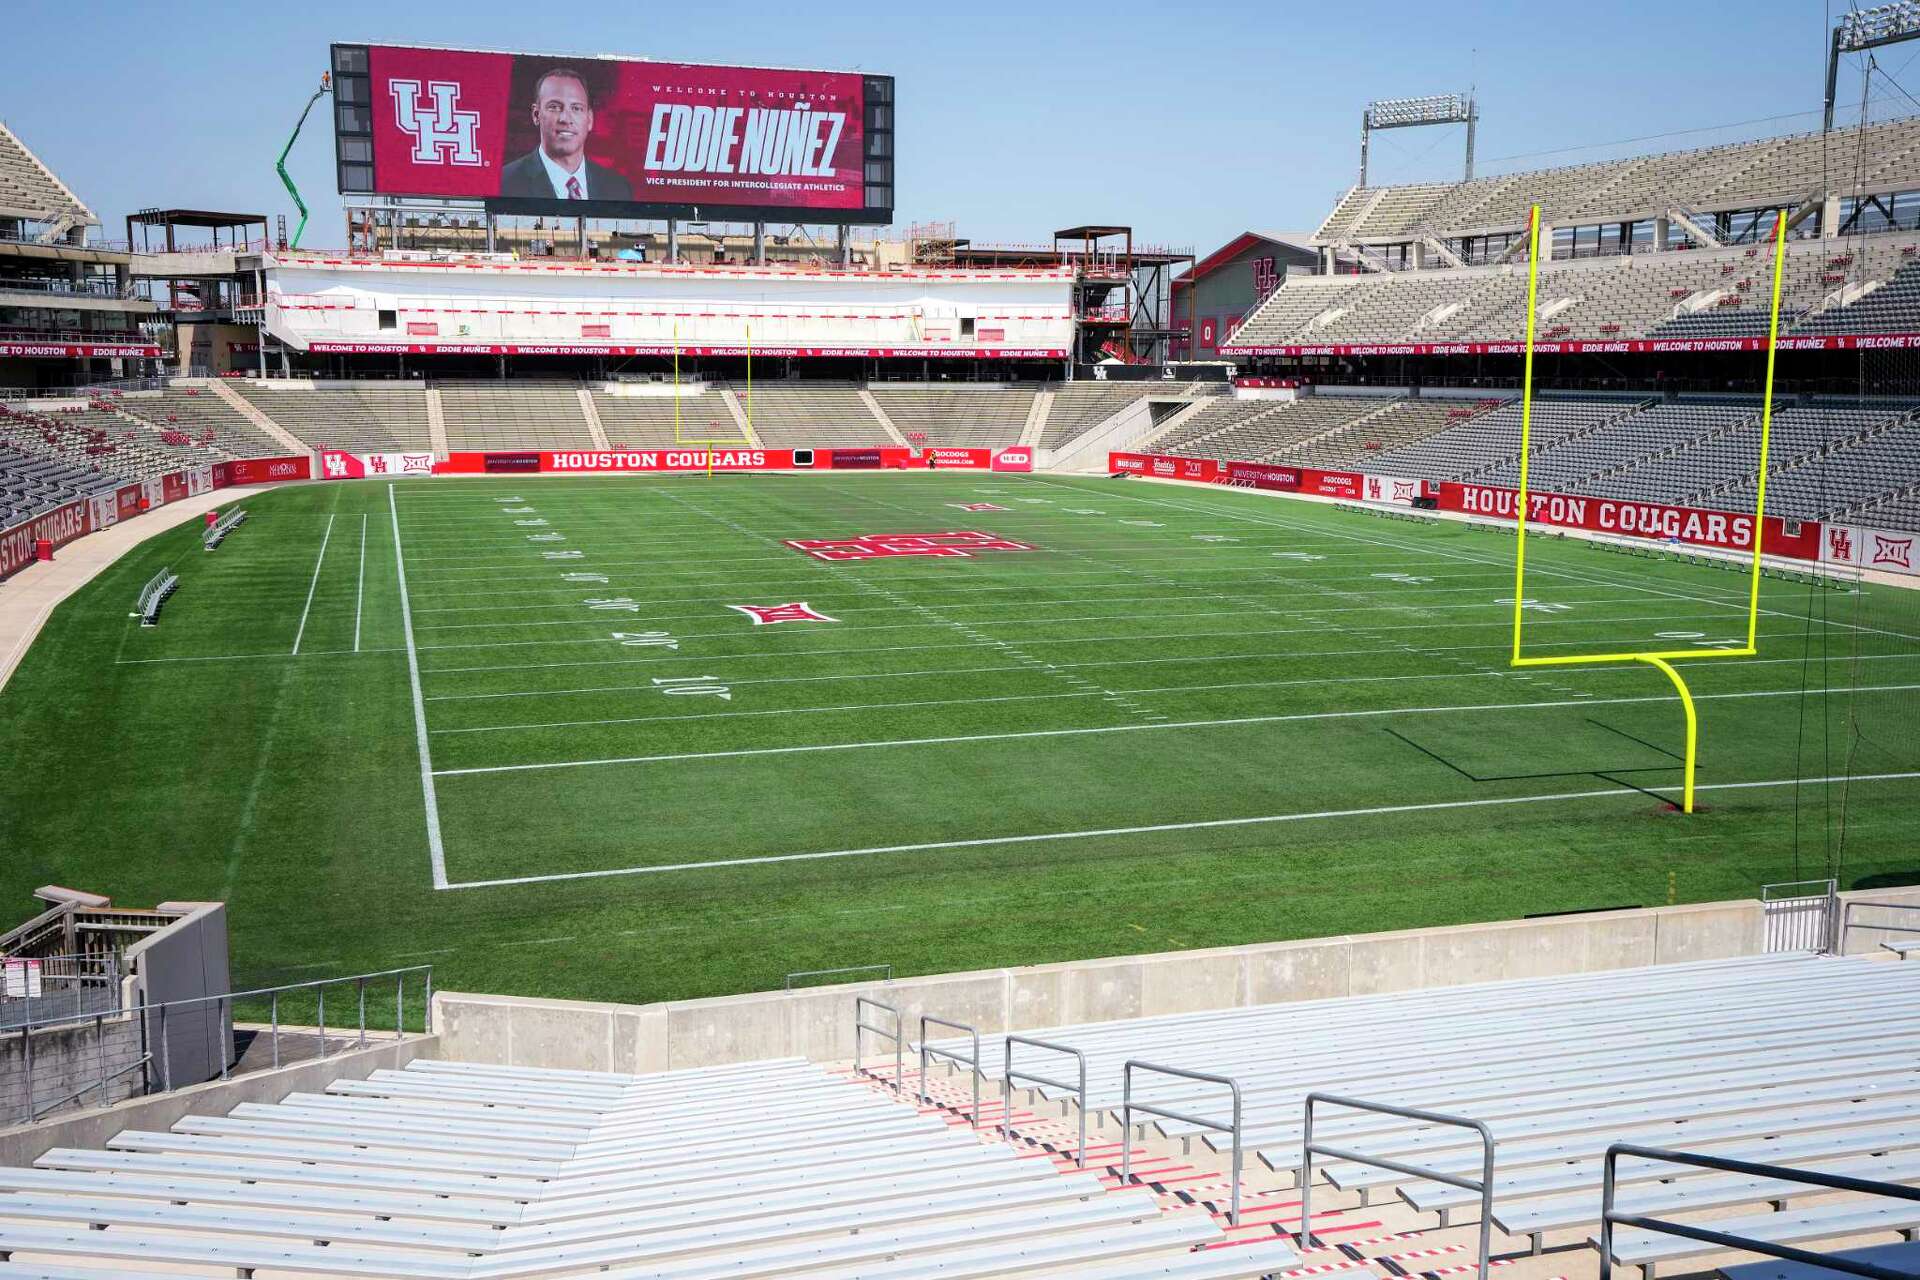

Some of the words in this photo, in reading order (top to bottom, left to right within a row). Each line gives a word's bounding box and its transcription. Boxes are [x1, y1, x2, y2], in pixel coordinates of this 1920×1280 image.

[652, 85, 727, 96] WELCOME
[768, 92, 837, 101] HOUSTON
[389, 79, 481, 167] UH
[644, 103, 744, 173] EDDIE
[738, 101, 846, 177] NUÑEZ
[646, 177, 665, 185] VICE
[667, 178, 711, 187] PRESIDENT
[713, 180, 730, 188] FOR
[731, 181, 801, 190] INTERCOLLEGIATE
[803, 183, 845, 192] ATHLETICS
[314, 344, 353, 352] WELCOME
[1582, 343, 1604, 352] EDDIE
[1653, 342, 1692, 351] WELCOME
[1693, 342, 1704, 350] TO
[1704, 341, 1742, 350] HOUSTON
[1795, 337, 1826, 349] NUÑEZ
[1856, 337, 1904, 348] WELCOME
[1907, 336, 1920, 347] TO
[11, 346, 21, 355] TO
[24, 346, 66, 356] HOUSTON
[93, 348, 117, 356] EDDIE
[517, 346, 559, 354] WELCOME
[571, 347, 609, 355] HOUSTON
[1351, 347, 1378, 355] WELCOME
[1386, 346, 1415, 354] HOUSTON
[553, 453, 657, 468] HOUSTON
[666, 452, 765, 467] COUGARS
[1233, 469, 1262, 480] UNIVERSITY
[1267, 472, 1294, 483] HOUSTON
[35, 505, 83, 546] COUGARS
[1599, 502, 1752, 546] COUGARS
[1829, 527, 1852, 561] UH
[651, 675, 732, 700] 10
